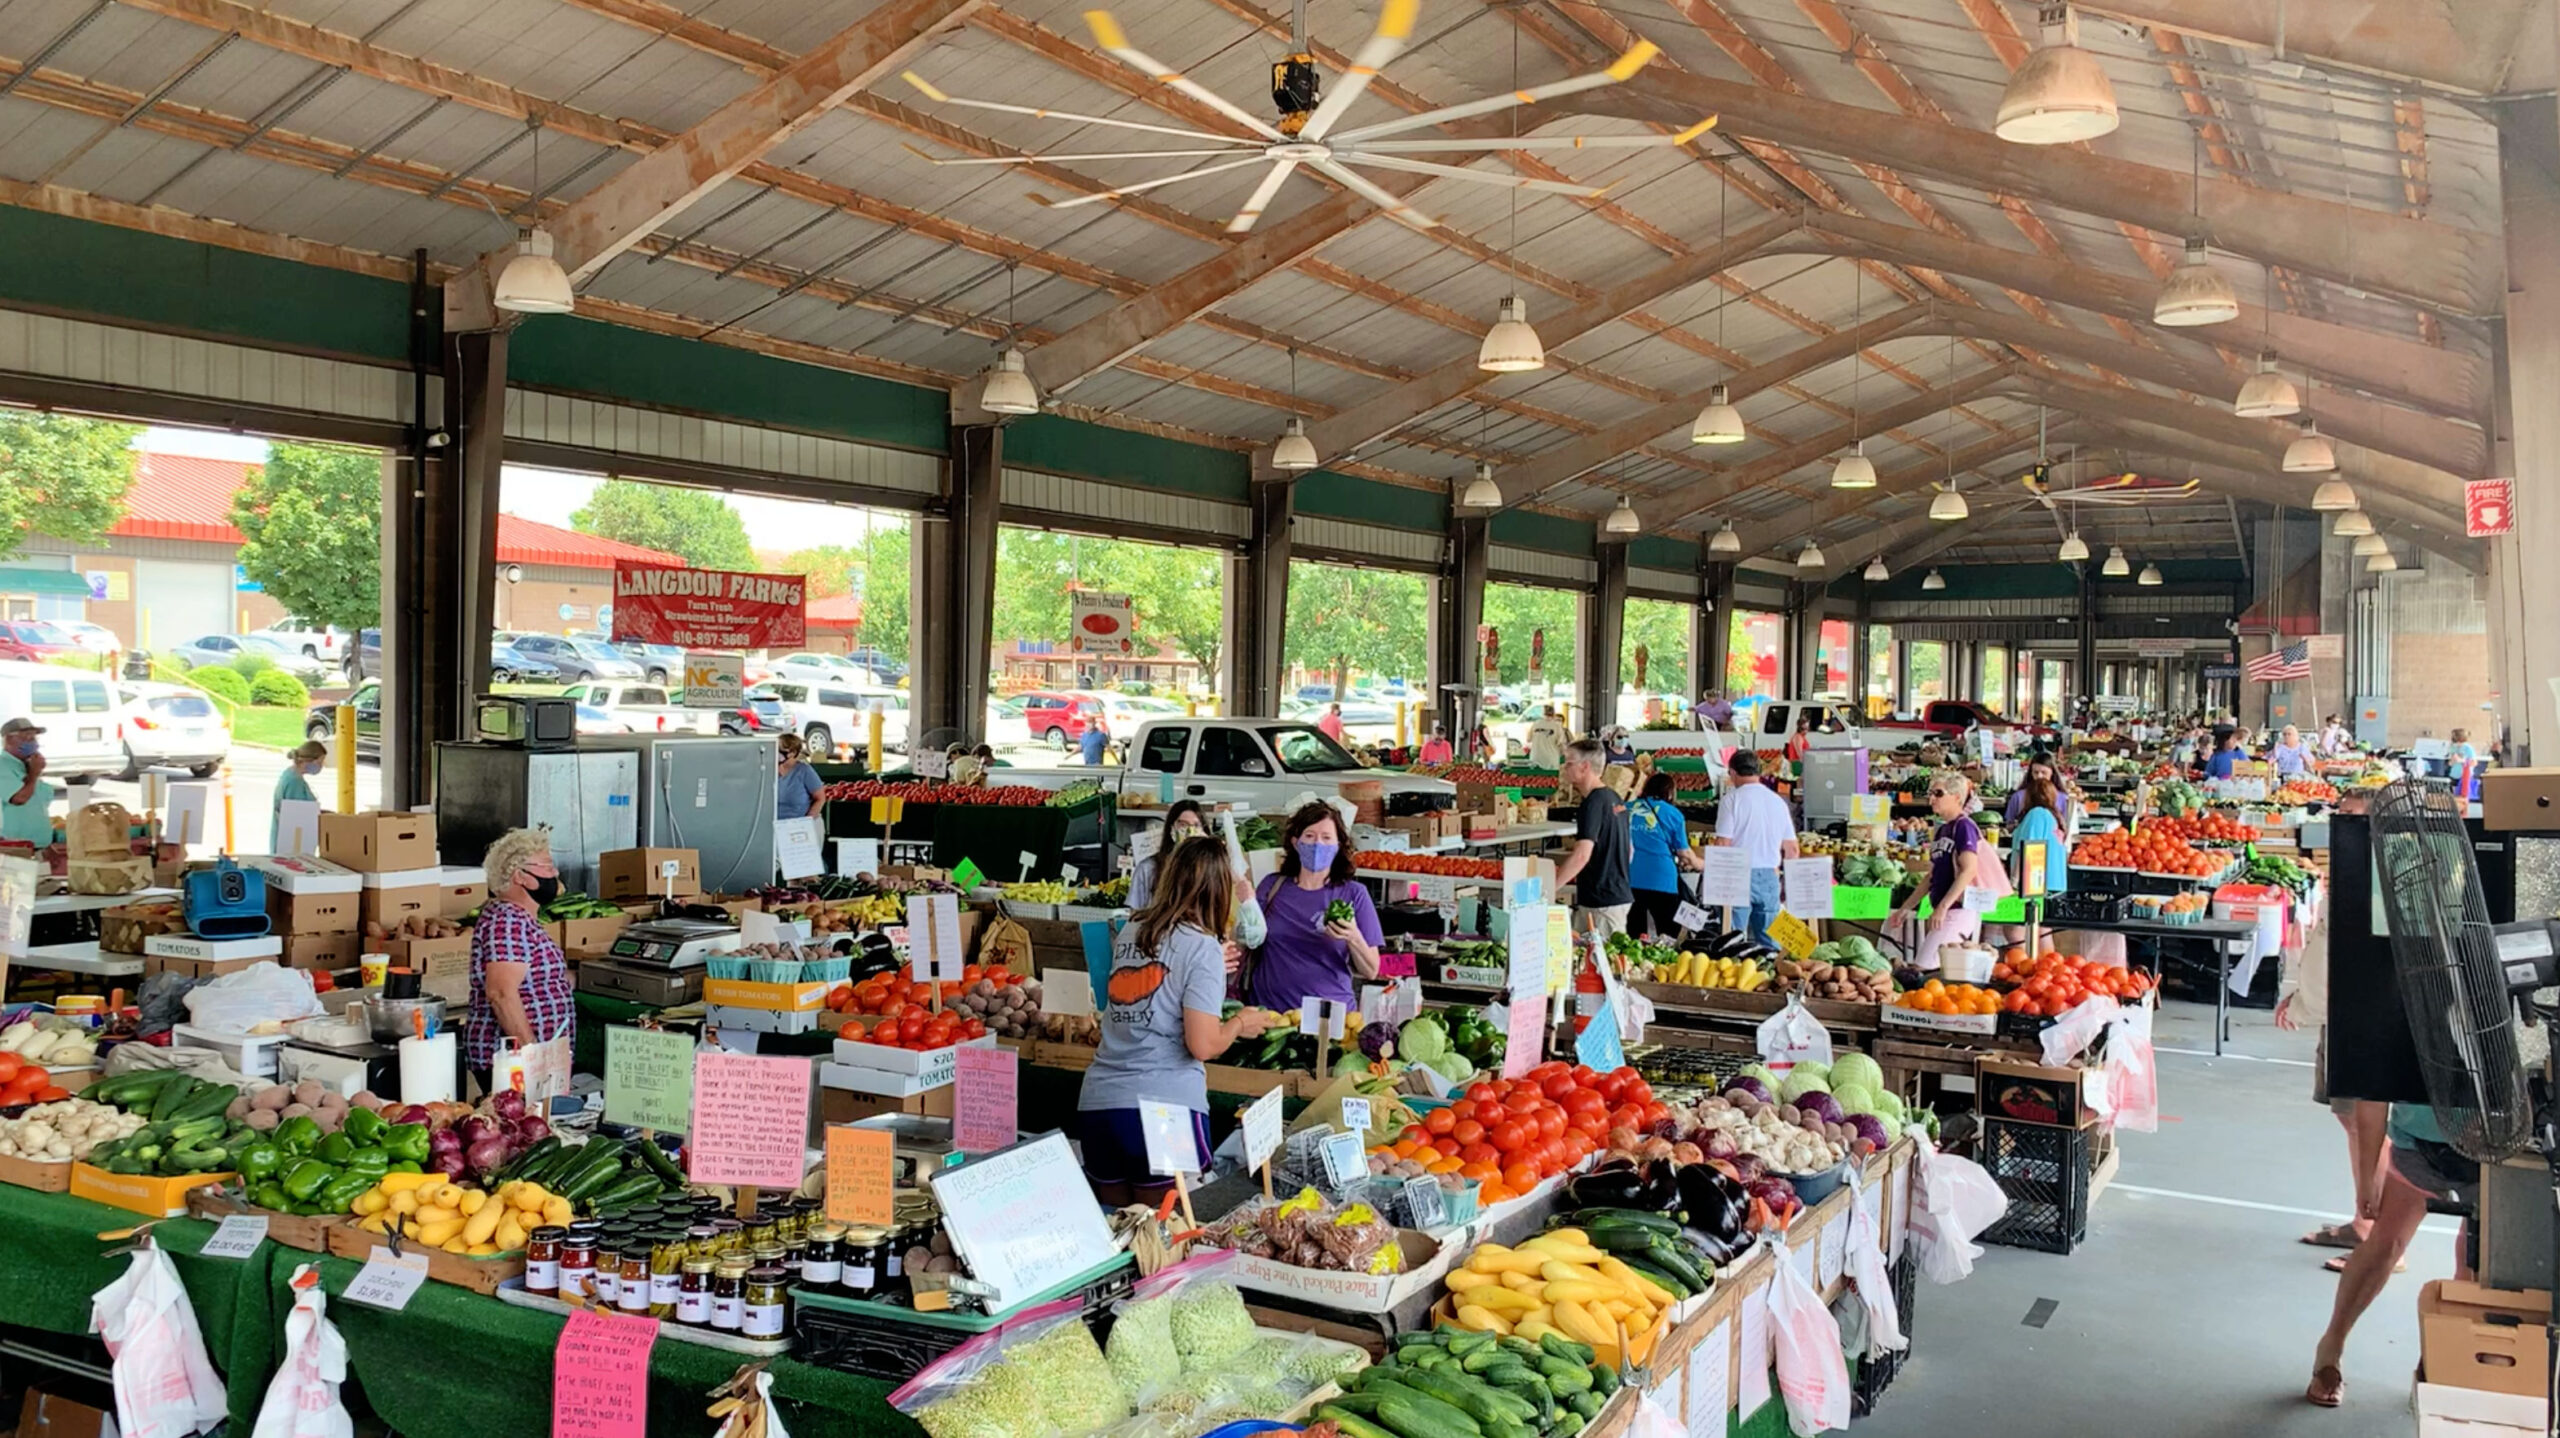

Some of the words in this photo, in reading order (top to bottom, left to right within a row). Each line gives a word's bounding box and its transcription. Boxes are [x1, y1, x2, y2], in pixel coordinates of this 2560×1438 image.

[2475, 487, 2503, 500] FIRE
[616, 571, 723, 597] LANGDON
[729, 574, 801, 606] FARMS
[1102, 594, 1123, 608] Produce
[665, 610, 715, 622] Strawberries
[725, 614, 759, 624] Produce
[687, 667, 719, 687] NC
[2204, 668, 2240, 678] RESTROO
[687, 688, 741, 699] AGRICULTURE
[156, 943, 201, 956] TOMATOES
[739, 990, 782, 1002] TOMATOES
[1891, 1012, 1932, 1025] TOMATOES
[724, 1057, 757, 1066] Welcome
[919, 1067, 955, 1087] TOMATO
[1246, 1262, 1272, 1282] Ripe
[1273, 1269, 1301, 1289] Vine
[1302, 1276, 1343, 1294] Packed
[1345, 1281, 1378, 1298] Place
